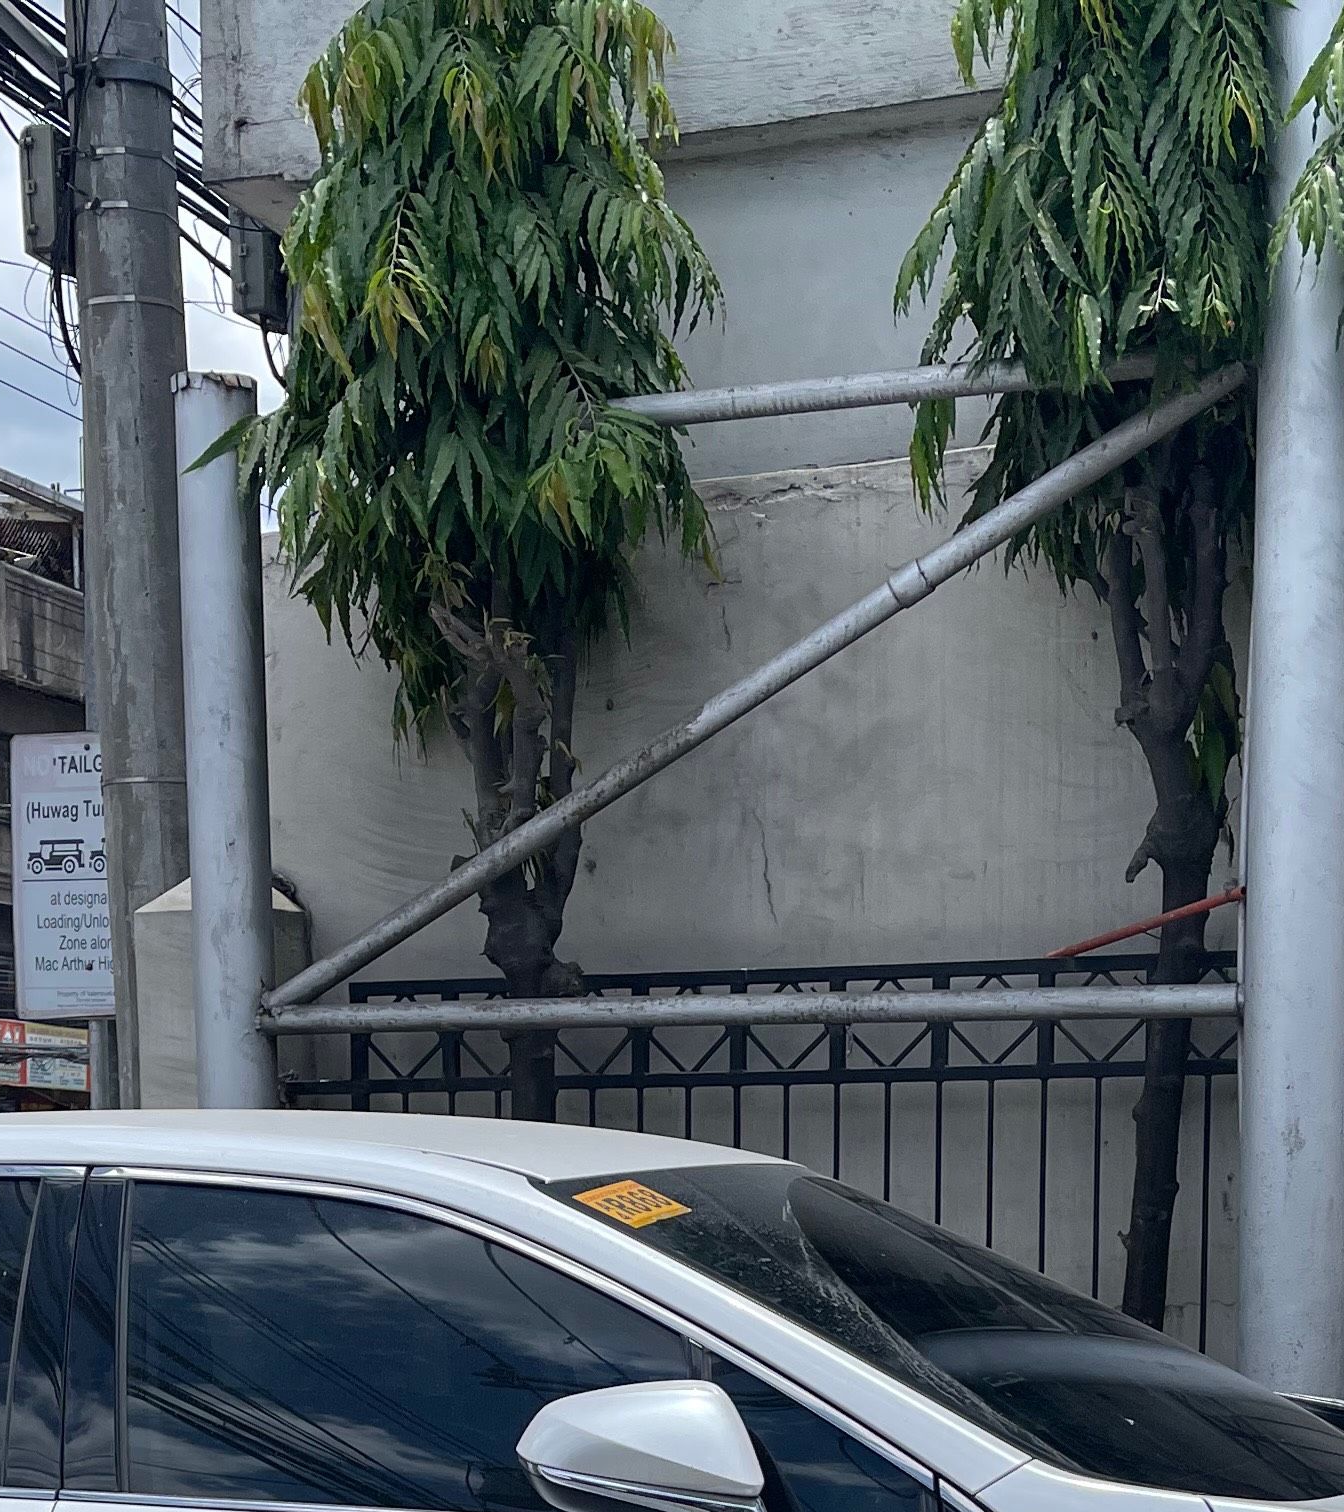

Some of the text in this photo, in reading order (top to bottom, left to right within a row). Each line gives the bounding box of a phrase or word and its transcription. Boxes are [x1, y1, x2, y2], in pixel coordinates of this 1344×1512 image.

[26, 801, 79, 823] (Huwag
[50, 891, 107, 909] at designa
[59, 935, 87, 950] Zone
[35, 956, 58, 972] Mac
[61, 956, 95, 972] Arthur
